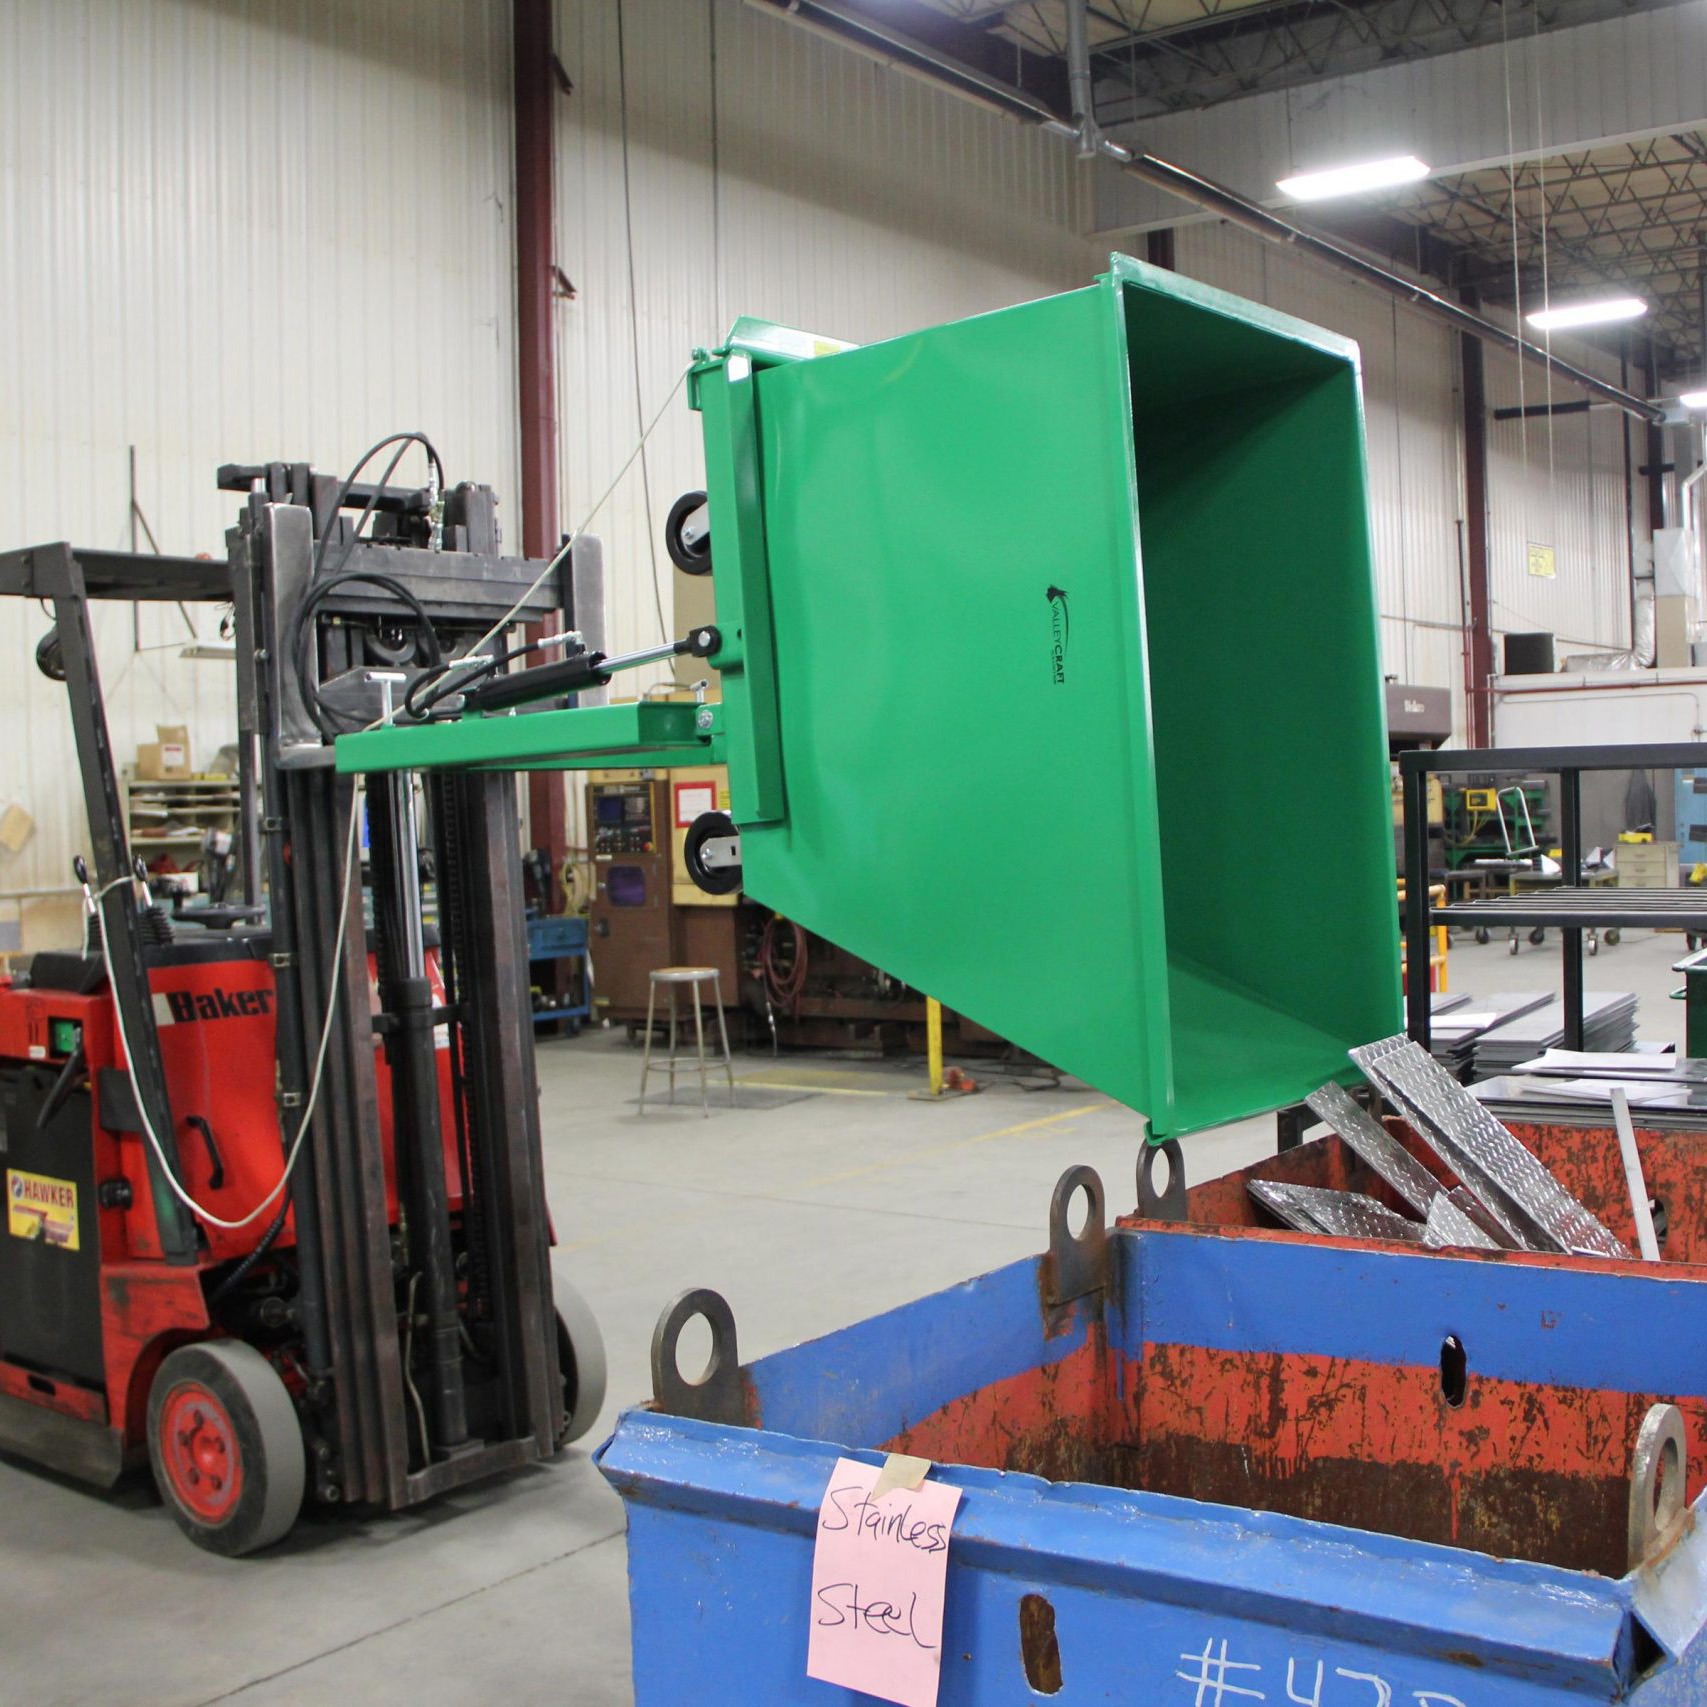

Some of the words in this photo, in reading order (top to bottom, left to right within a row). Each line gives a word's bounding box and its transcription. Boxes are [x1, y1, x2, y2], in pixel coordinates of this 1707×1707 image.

[167, 987, 274, 1023] Baker
[24, 1179, 75, 1209] HAWKER
[821, 1485, 947, 1553] Stainless
[817, 1583, 938, 1649] Steel
